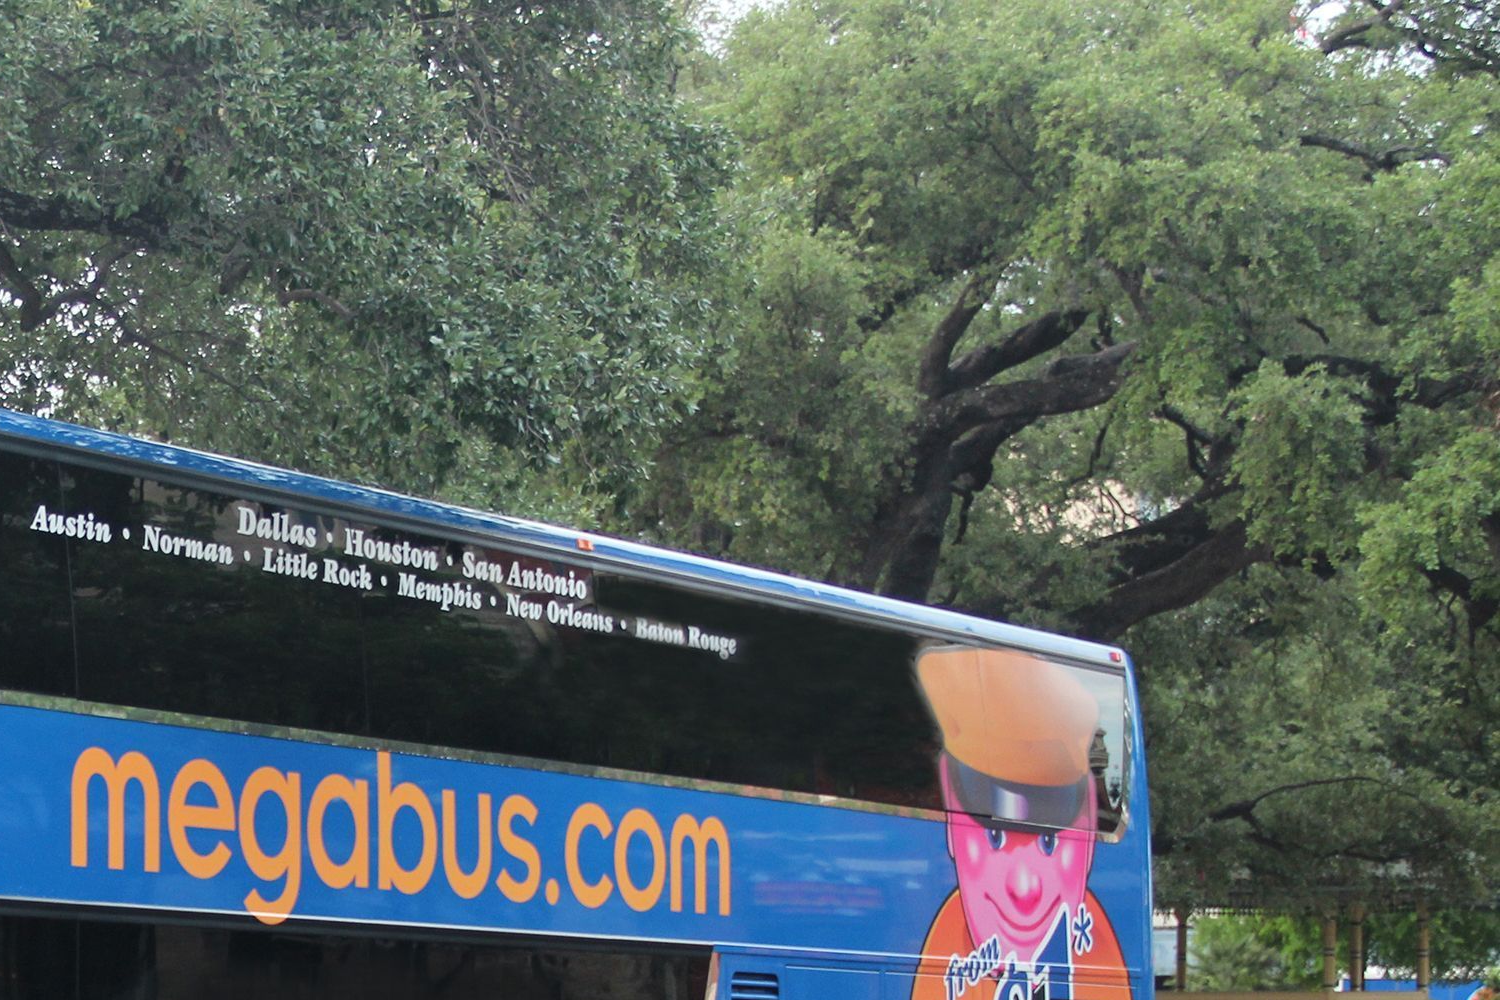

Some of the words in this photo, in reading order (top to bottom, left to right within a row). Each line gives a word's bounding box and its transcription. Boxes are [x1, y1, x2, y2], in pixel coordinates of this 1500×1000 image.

[30, 504, 113, 543] Austin
[142, 524, 234, 565] Norman
[262, 547, 318, 581] Little
[322, 558, 373, 591] Rock
[397, 572, 482, 612] Memphis
[505, 593, 543, 621] New
[546, 600, 614, 633] Orleans
[634, 617, 685, 645] Baton
[687, 625, 737, 660] Rouge
[237, 506, 318, 548] Dallas
[344, 528, 439, 571] Houston
[462, 550, 503, 584] San
[506, 561, 587, 599] Antonio
[70, 746, 731, 925] megabus.com
